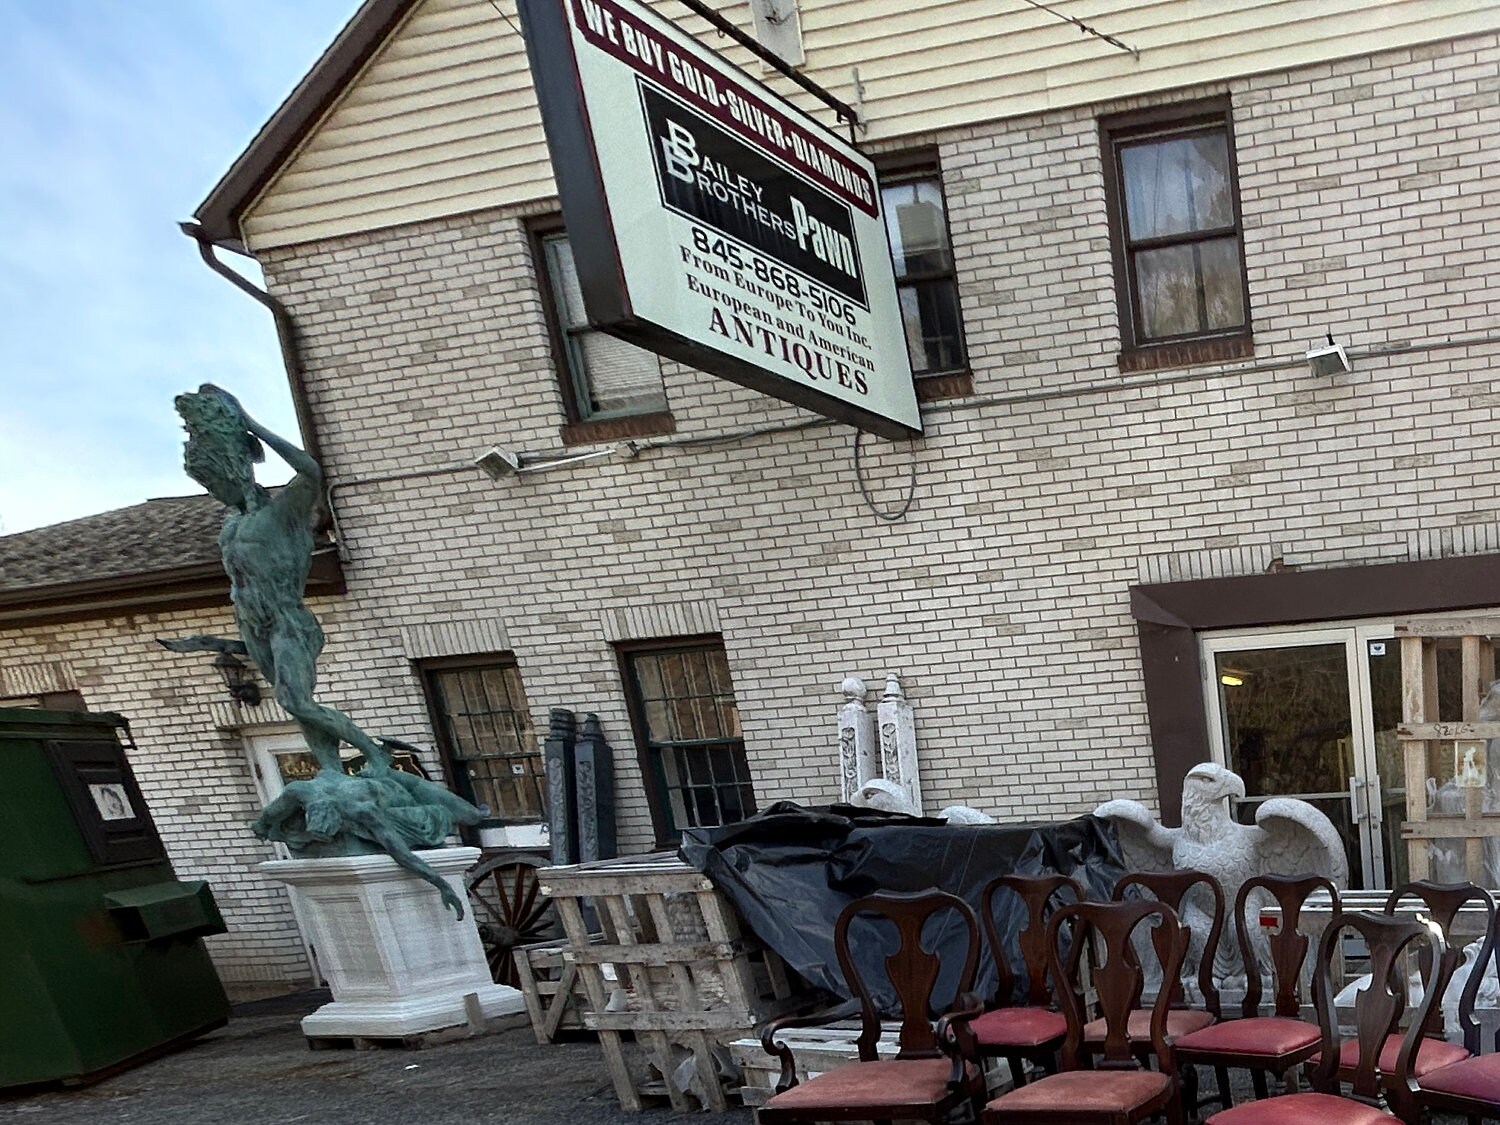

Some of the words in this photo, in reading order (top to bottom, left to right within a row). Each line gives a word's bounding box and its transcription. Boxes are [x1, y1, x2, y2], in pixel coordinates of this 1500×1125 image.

[581, 0, 619, 46] WE
[620, 19, 665, 74] BUY
[667, 51, 720, 107] GOLD
[660, 136, 797, 241] BROTHERS
[666, 118, 763, 203] BAILEY
[692, 226, 857, 326] 845-868-5106
[790, 195, 857, 279] Pawn
[680, 245, 731, 283] From
[733, 269, 794, 312] Europe
[795, 300, 816, 322] To
[817, 312, 844, 336] You
[686, 272, 774, 326] European
[776, 319, 805, 340] and
[808, 330, 875, 372] American
[709, 306, 869, 396] ANTIQUES
